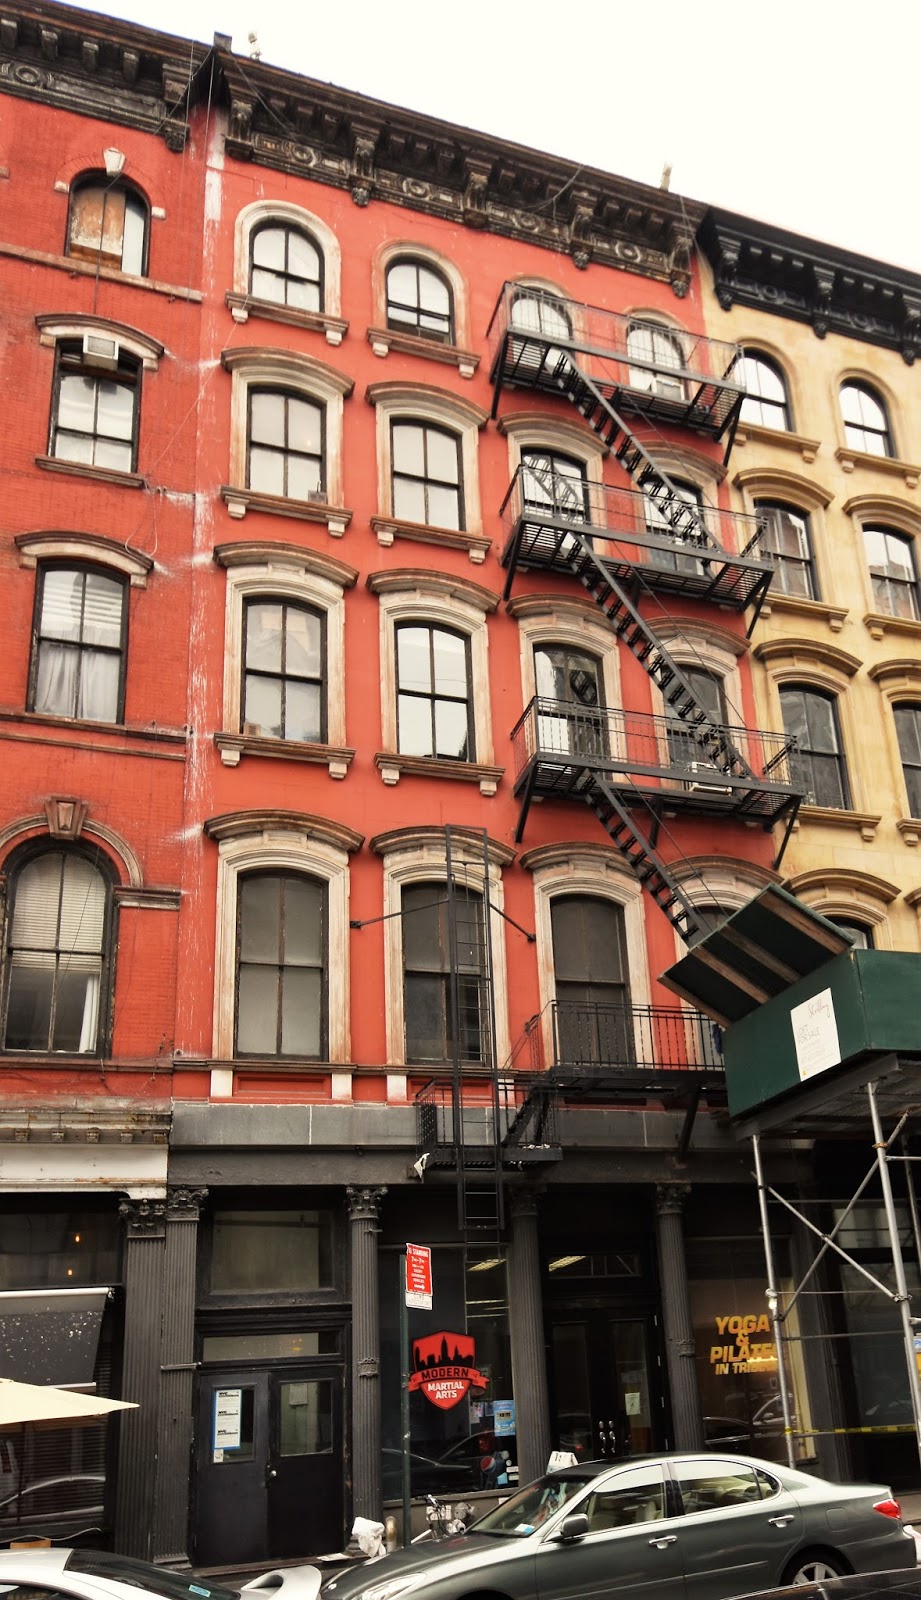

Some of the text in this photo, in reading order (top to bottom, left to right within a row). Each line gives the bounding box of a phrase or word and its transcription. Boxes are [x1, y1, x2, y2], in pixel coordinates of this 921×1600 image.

[715, 1314, 770, 1335] YOGA
[736, 1329, 750, 1347] &
[421, 1367, 469, 1380] MODERN
[715, 1363, 729, 1375] IN
[427, 1381, 465, 1391] MARTIAL
[435, 1390, 458, 1399] ARTS
